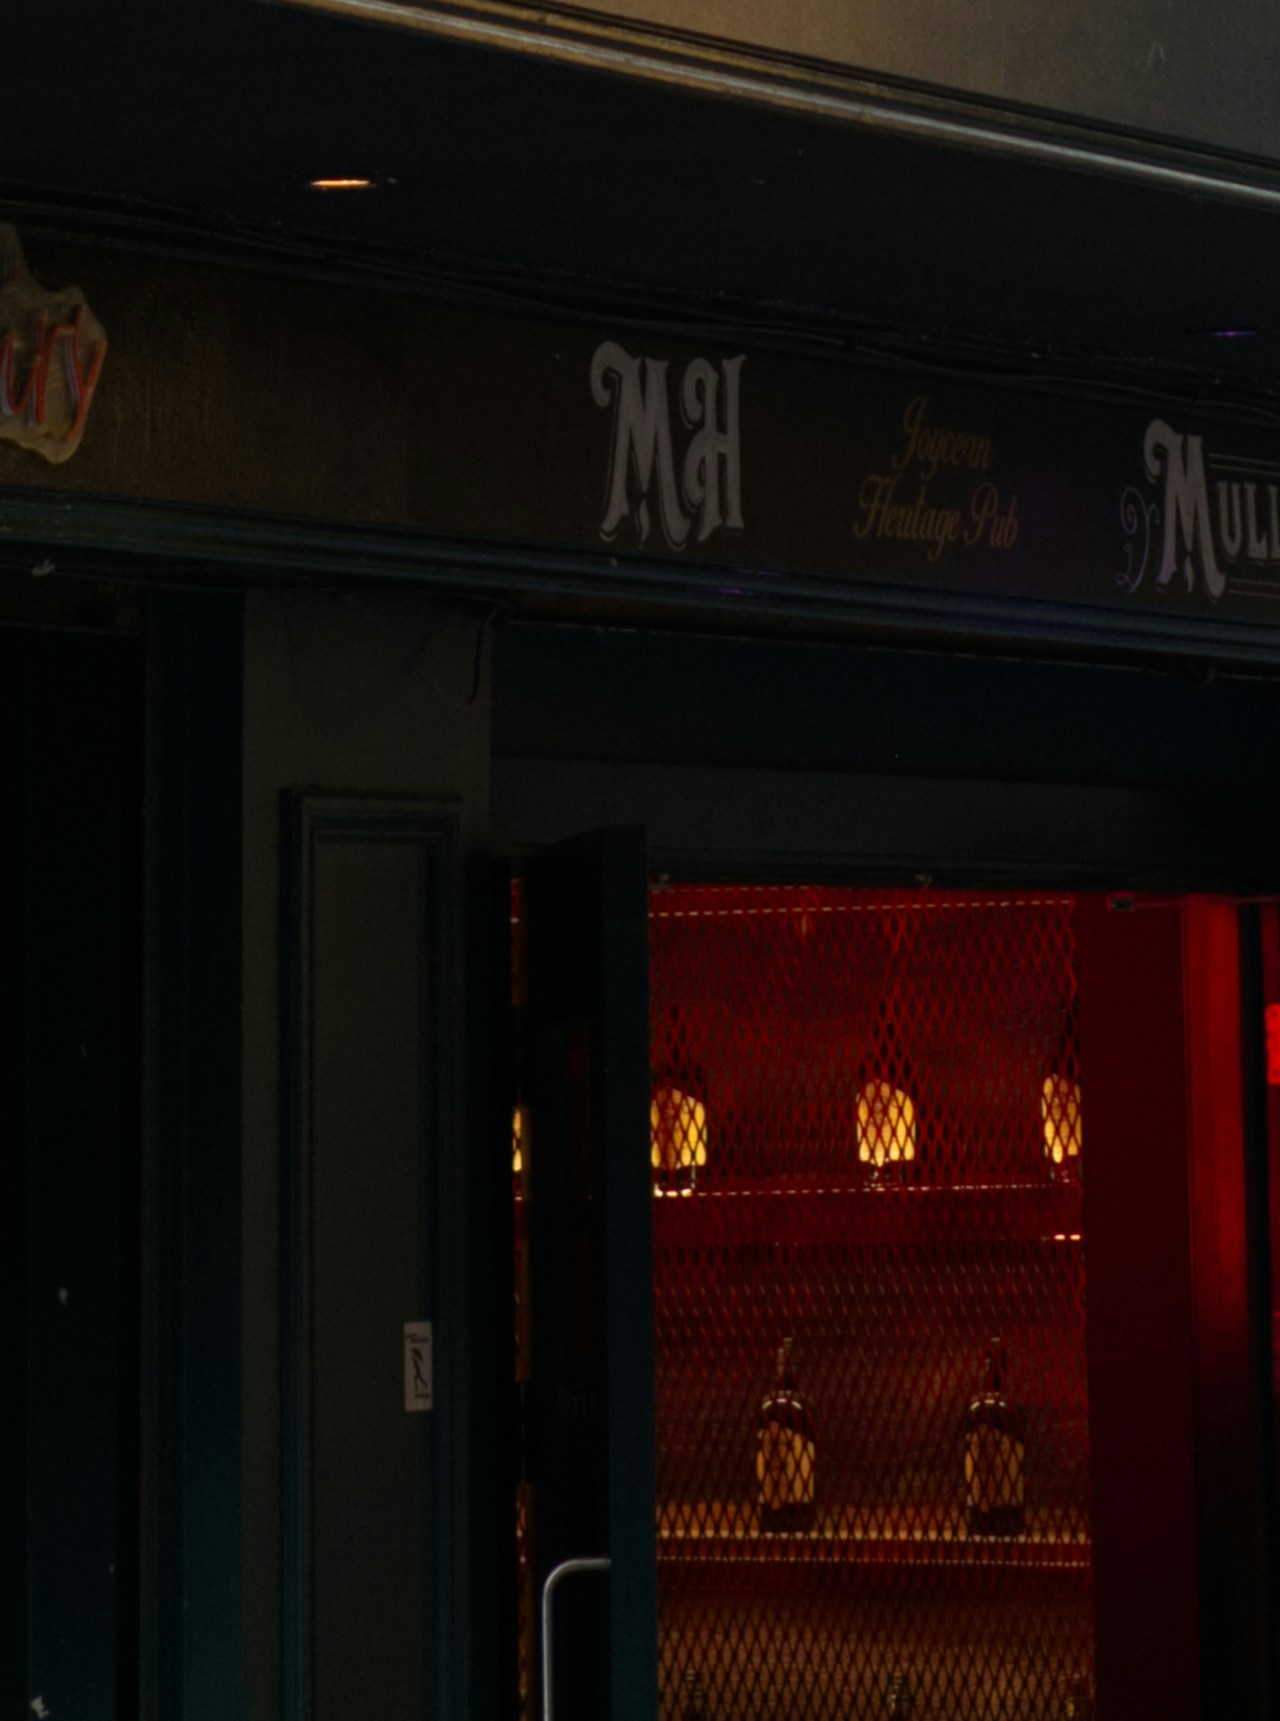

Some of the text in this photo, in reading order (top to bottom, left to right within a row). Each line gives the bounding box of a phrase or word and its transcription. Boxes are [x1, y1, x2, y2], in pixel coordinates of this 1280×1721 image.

[589, 338, 749, 552] MH
[891, 395, 994, 481] Joycean
[853, 471, 1019, 562] Heritage Pub
